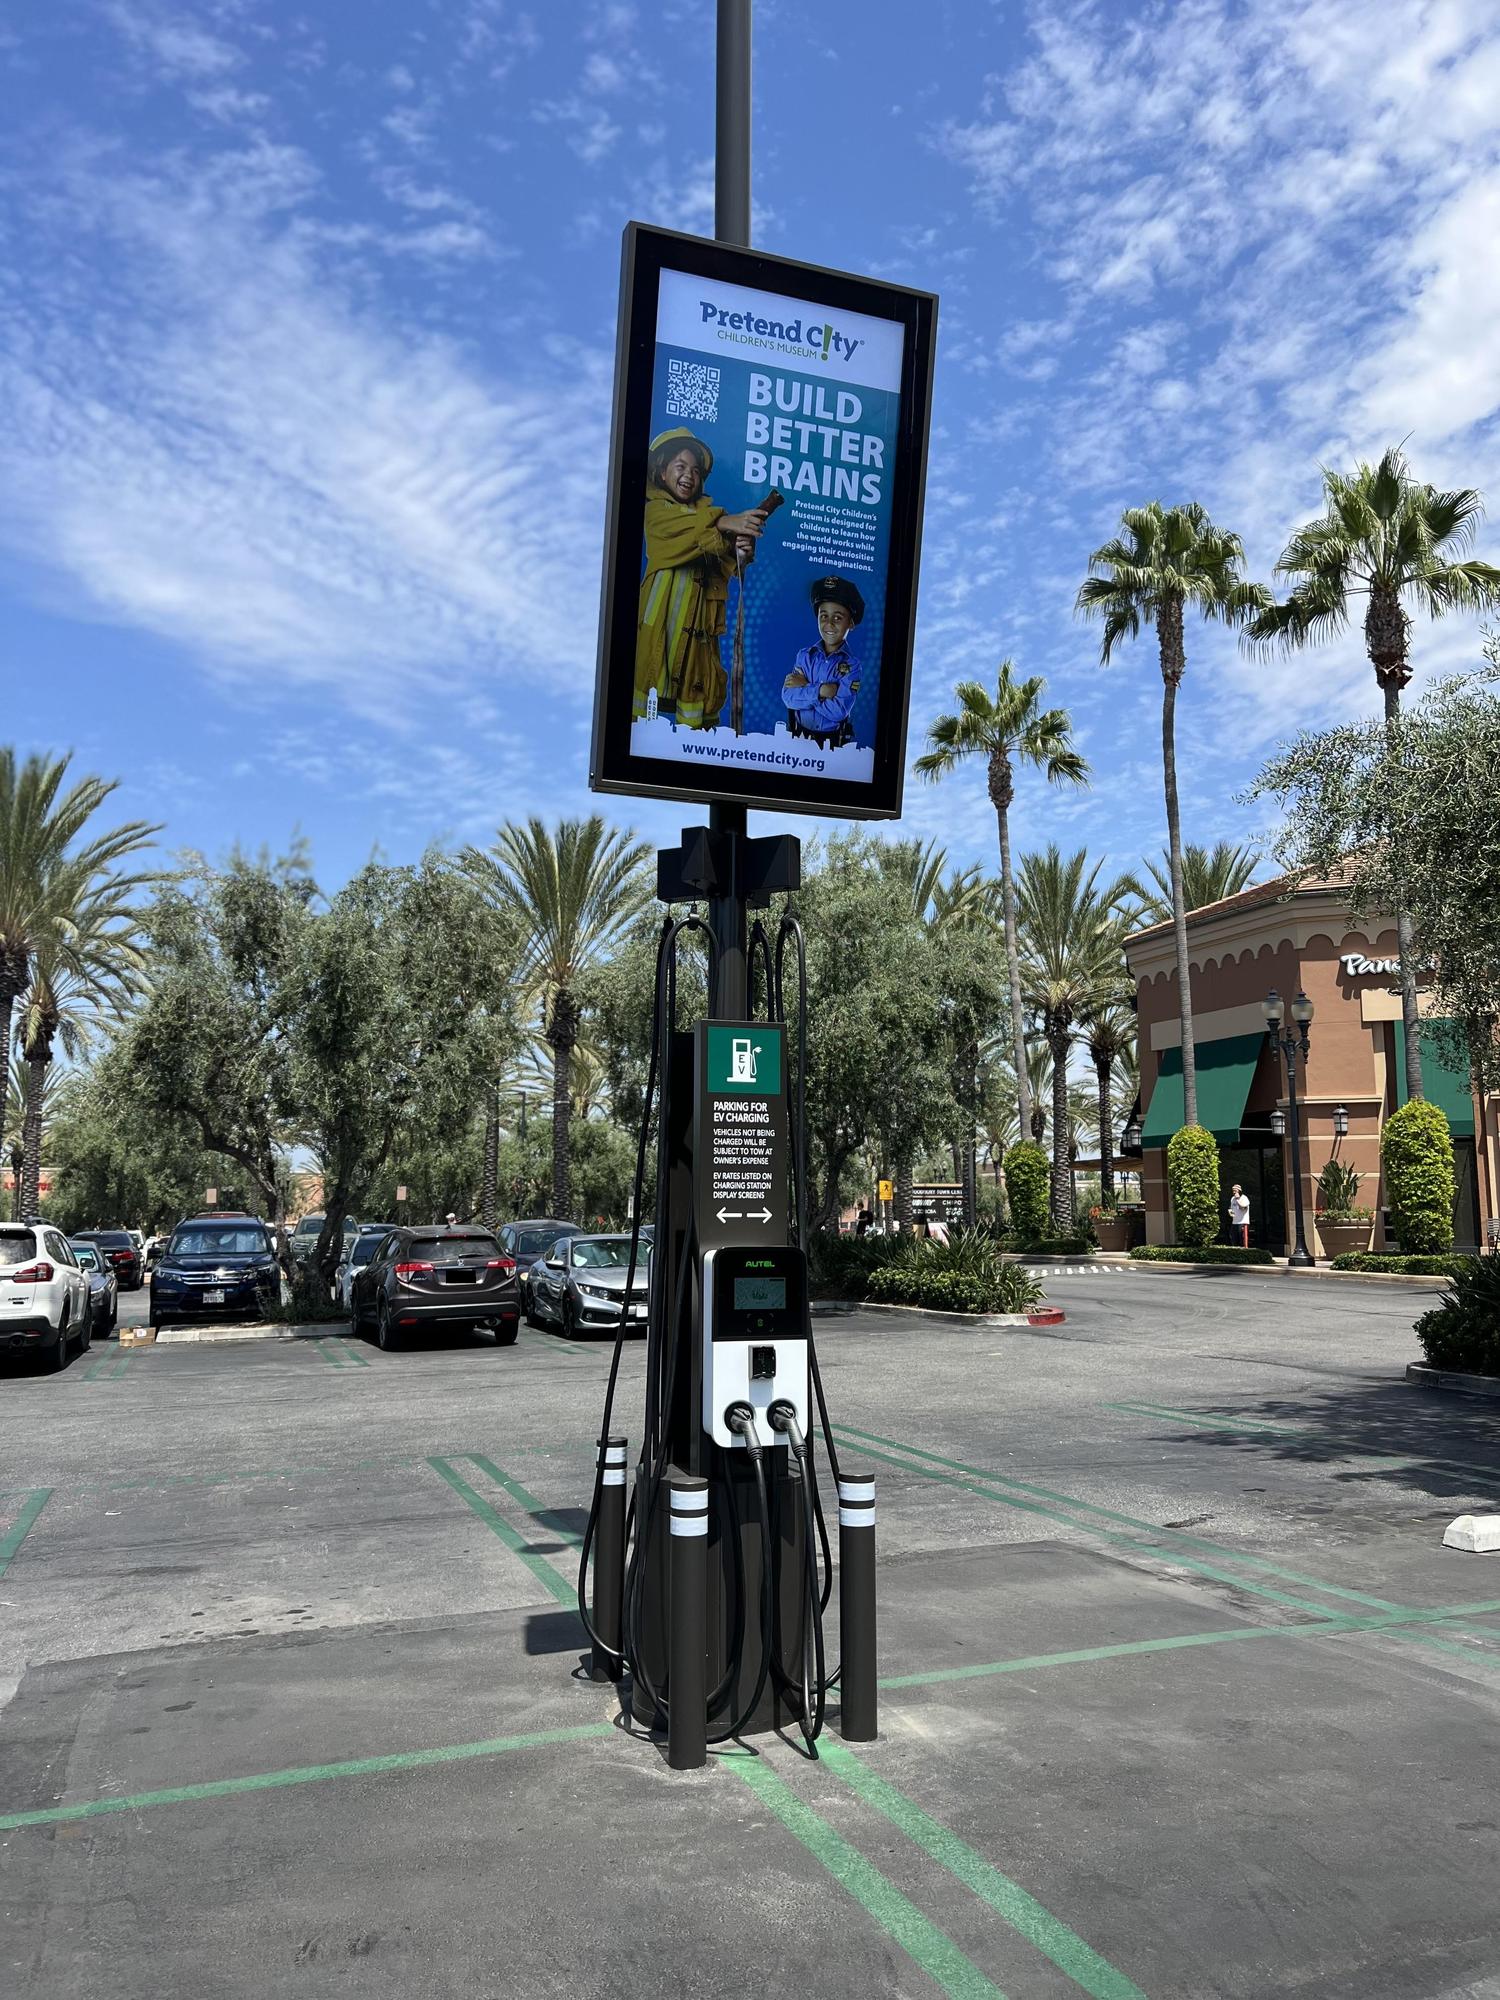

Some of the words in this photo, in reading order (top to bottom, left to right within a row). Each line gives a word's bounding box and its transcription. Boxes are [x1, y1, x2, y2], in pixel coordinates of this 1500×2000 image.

[700, 300, 802, 344] Pretend
[717, 330, 775, 351] CHILDREN'S
[776, 343, 818, 360] MUSEUM
[748, 372, 863, 424] BUILD
[746, 411, 885, 469] BETTER
[743, 450, 882, 505] BRAINS
[795, 499, 825, 512] Pretend
[825, 505, 841, 516] City
[841, 508, 878, 522] Children's
[791, 509, 823, 523] Museum
[823, 515, 831, 524] is
[831, 516, 865, 530] designed
[865, 522, 877, 532] for
[799, 521, 830, 534] children
[831, 528, 840, 536] to
[840, 528, 859, 540] learn
[860, 532, 876, 542] how
[782, 540, 817, 554] engaging
[818, 545, 836, 556] their
[836, 549, 875, 562] curiosities
[796, 531, 810, 541] the
[810, 535, 832, 545] world
[832, 539, 854, 549] works
[855, 542, 876, 552] while
[808, 555, 823, 564] and
[824, 556, 874, 573] imaginations.
[682, 743, 826, 772] www.pretendcity.org
[713, 1101, 749, 1111] PARKING
[750, 1102, 768, 1112] FOR
[713, 1112, 725, 1122] EV
[725, 1112, 770, 1123] CHARGING
[713, 1128, 742, 1136] VEHICLES
[742, 1128, 756, 1137] NOT
[756, 1129, 776, 1137] BEING
[713, 1137, 743, 1146] CHARGED
[743, 1138, 758, 1146] WILL
[758, 1138, 767, 1146] BE
[713, 1147, 739, 1155] SUBJECT
[740, 1147, 750, 1155] TO
[750, 1147, 765, 1156] TOW
[713, 1156, 742, 1165] OWNER'S
[742, 1157, 769, 1165] EXPENSE
[713, 1172, 721, 1180] EV
[722, 1172, 741, 1180] RATES
[741, 1172, 761, 1181] LISTED
[762, 1172, 773, 1180] ON
[713, 1181, 746, 1190] CHARGING
[746, 1182, 772, 1190] STATION
[713, 1191, 738, 1199] DISPLAY
[738, 1191, 765, 1199] SCREENS
[745, 1260, 776, 1268] AUTEL
